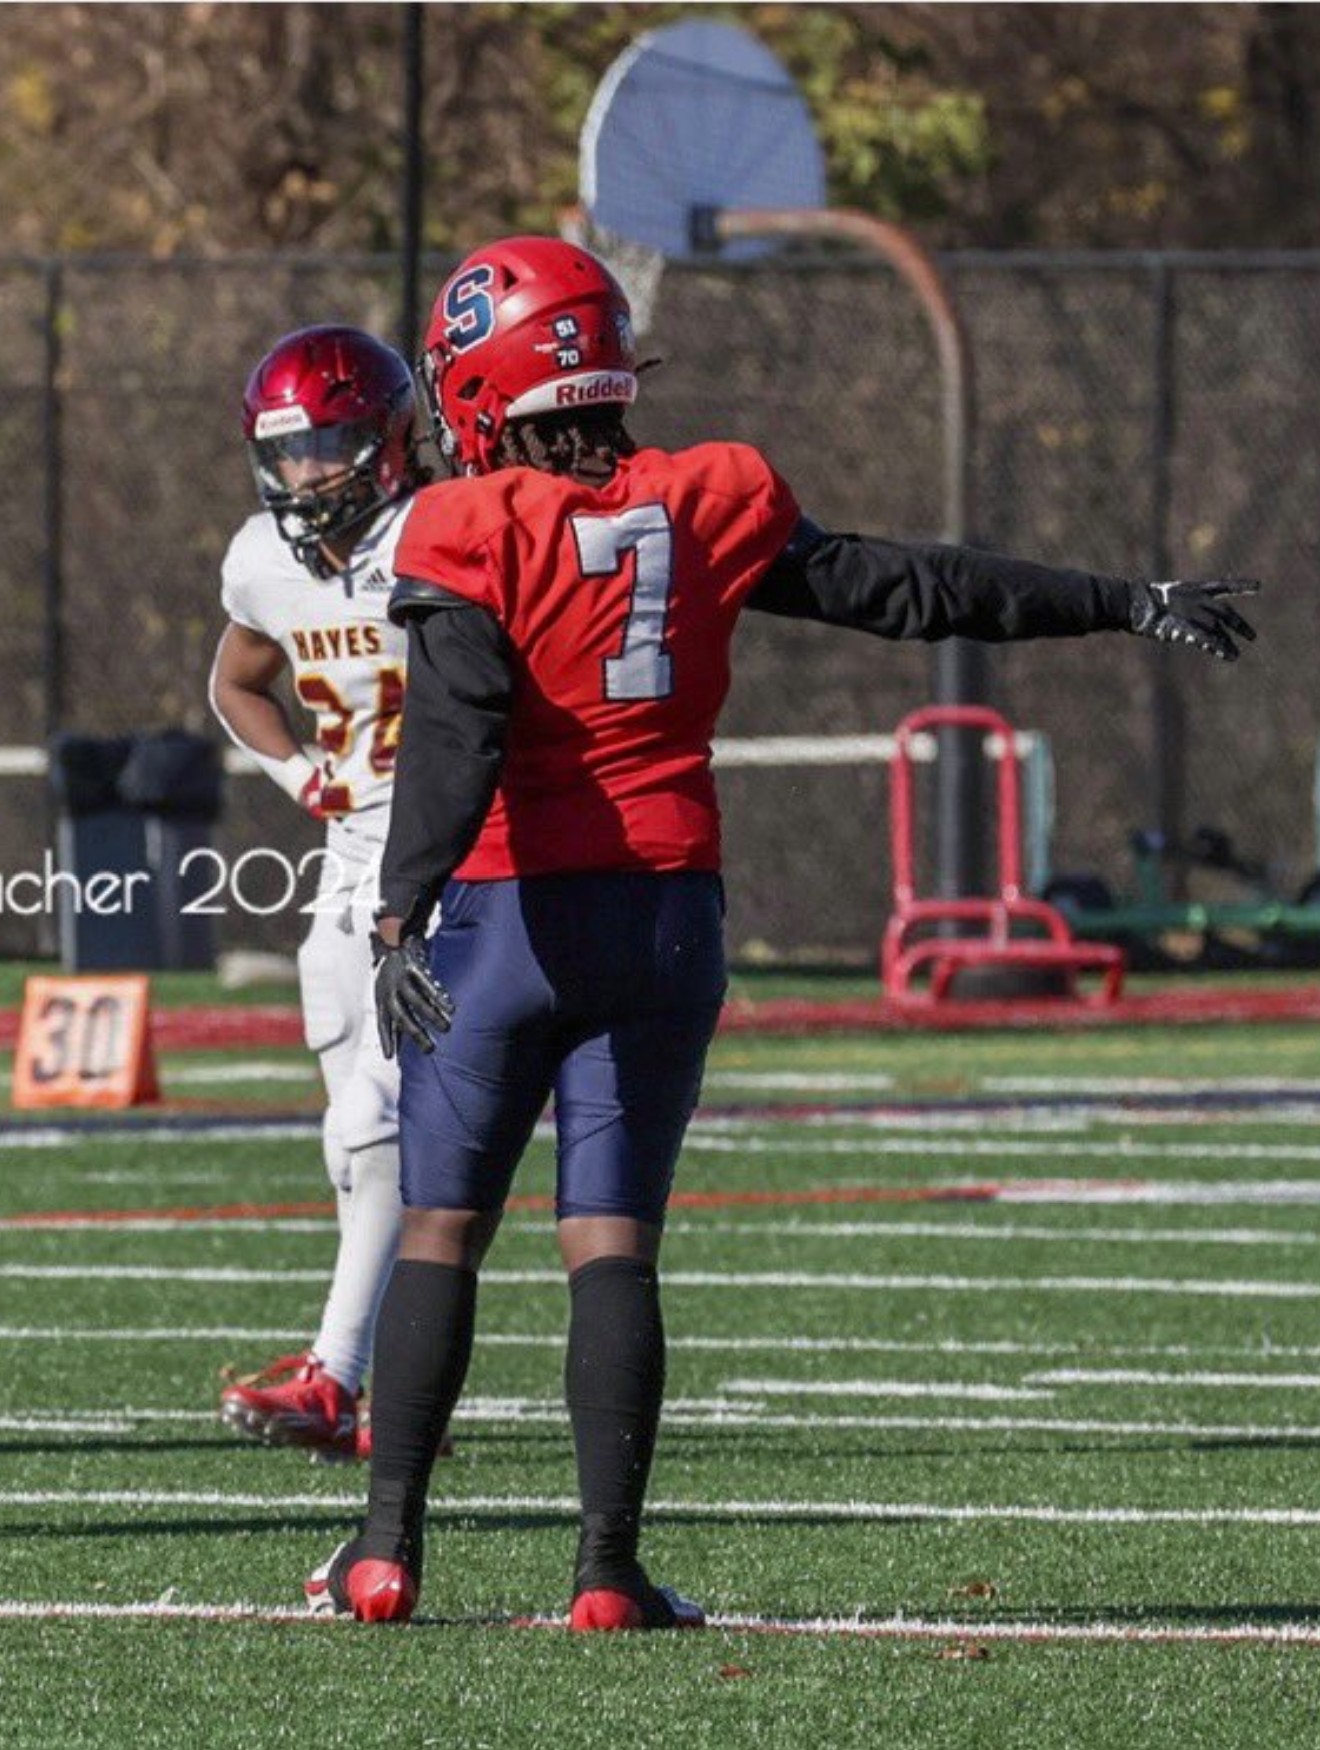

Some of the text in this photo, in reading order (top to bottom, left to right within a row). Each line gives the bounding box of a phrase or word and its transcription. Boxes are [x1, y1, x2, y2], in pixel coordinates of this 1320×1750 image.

[442, 263, 496, 355] S
[557, 348, 581, 368] 70
[291, 624, 382, 662] HAYES
[566, 499, 674, 704] 7
[31, 995, 121, 1083] 30
